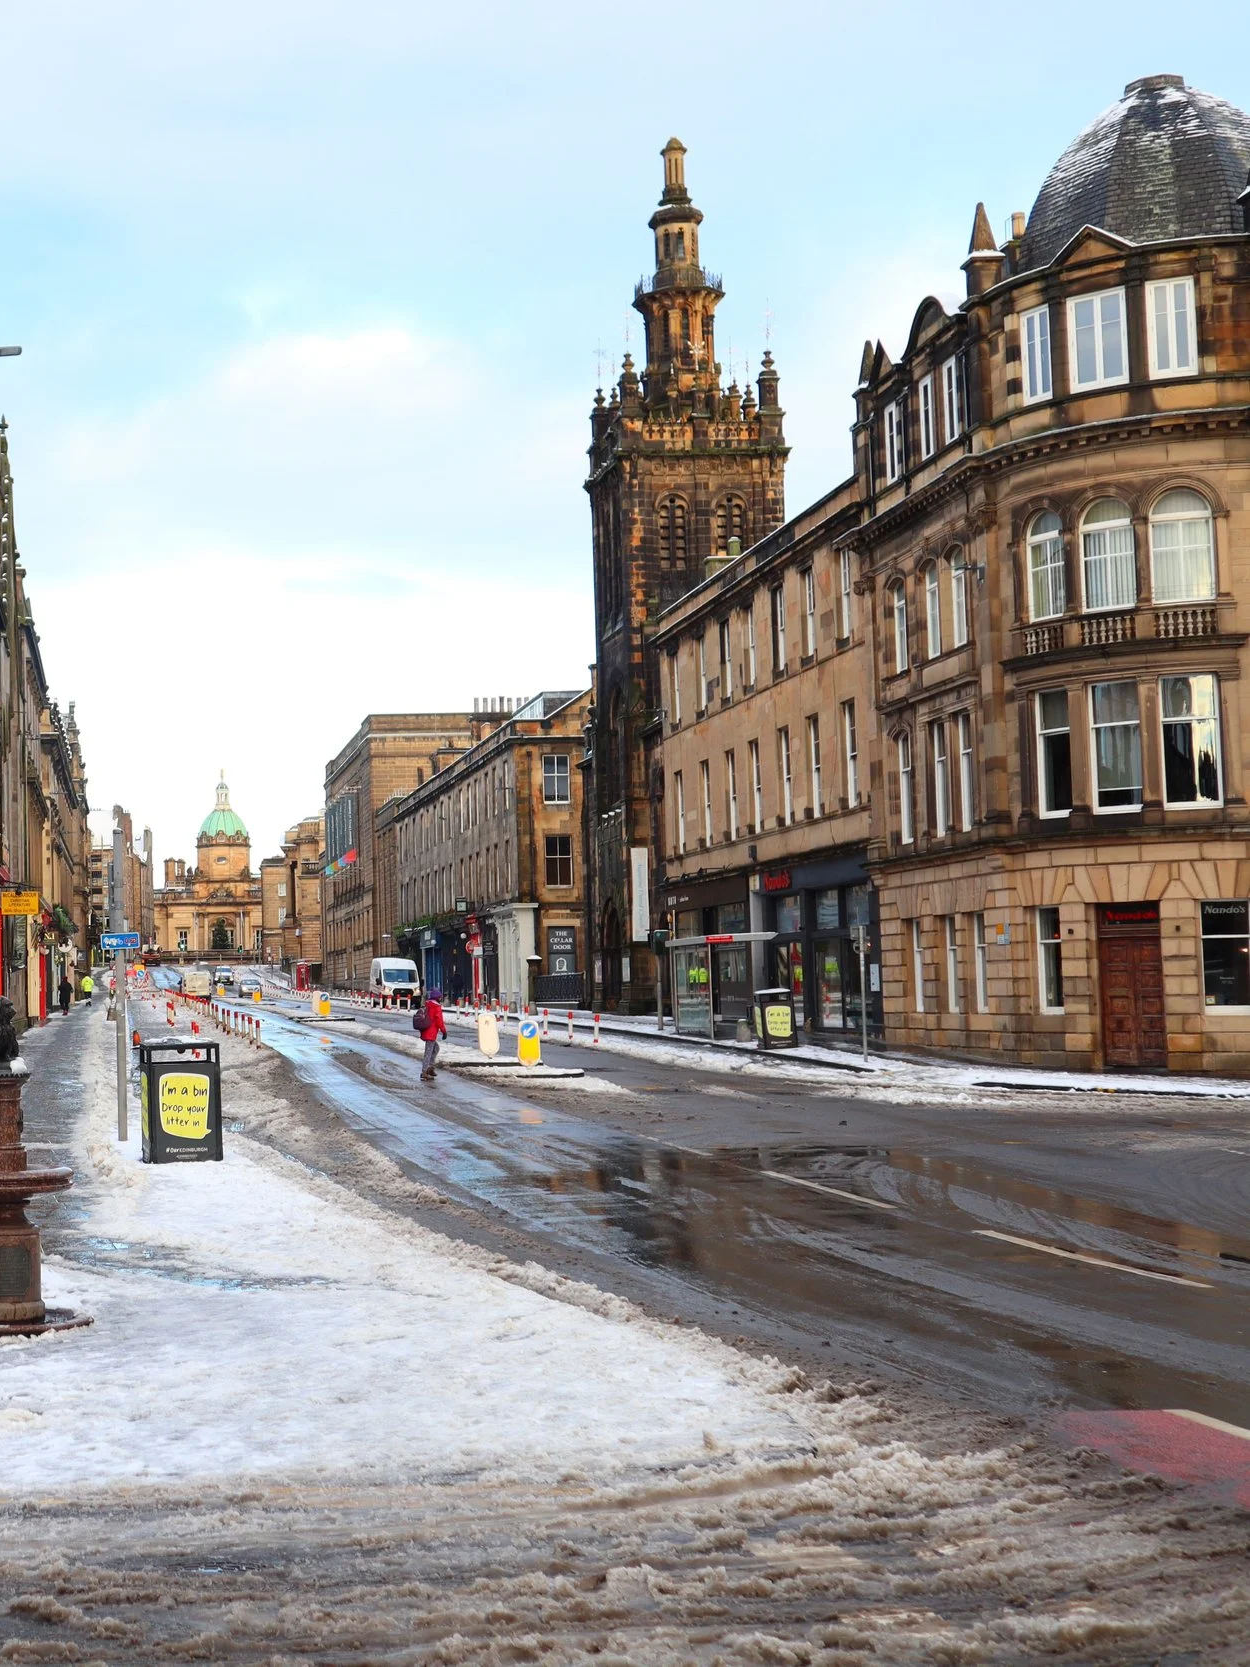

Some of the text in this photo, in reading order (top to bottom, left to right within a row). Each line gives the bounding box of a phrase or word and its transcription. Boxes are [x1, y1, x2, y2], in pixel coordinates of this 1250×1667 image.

[1204, 906, 1246, 914] Nando's
[162, 1081, 208, 1096] I'm a bin
[162, 1103, 206, 1115] Drop your
[166, 1117, 189, 1126] litter
